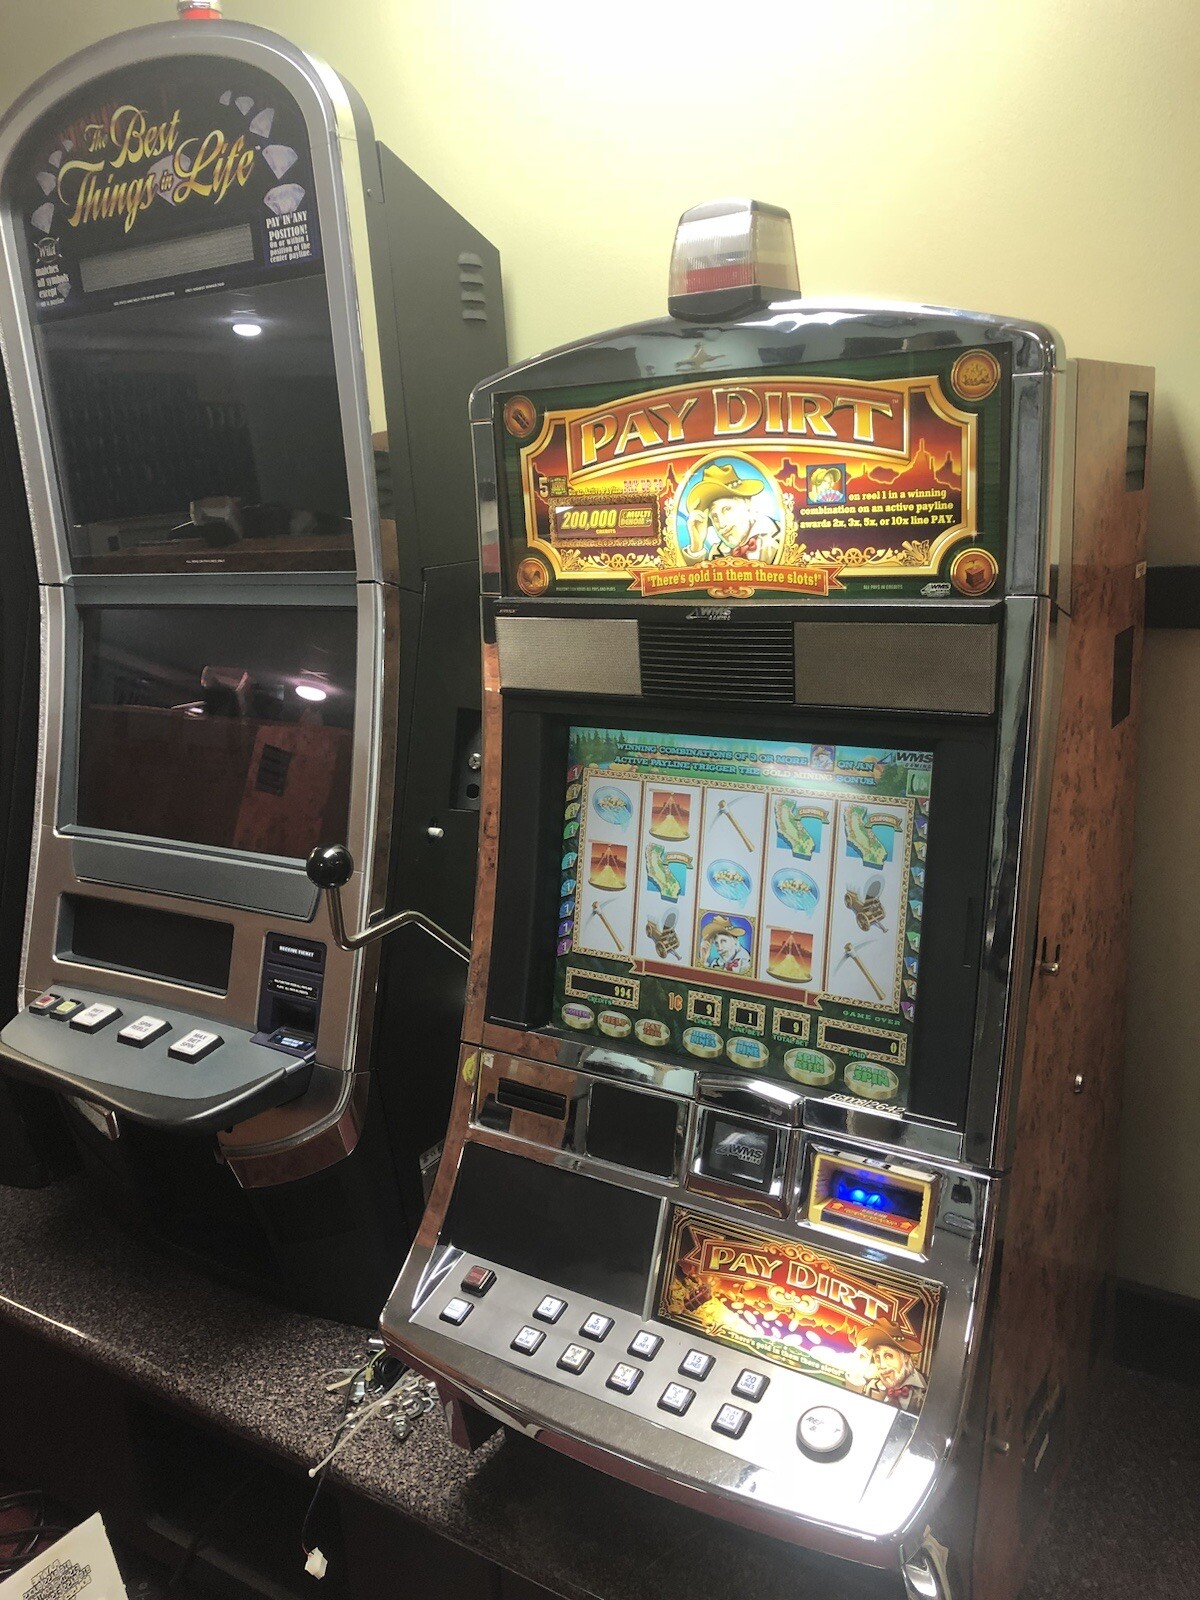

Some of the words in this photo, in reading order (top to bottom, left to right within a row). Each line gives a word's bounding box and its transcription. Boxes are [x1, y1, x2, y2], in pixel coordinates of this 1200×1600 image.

[84, 124, 108, 152] The
[109, 104, 181, 168] Best
[58, 160, 158, 233] Things
[160, 170, 174, 192] in
[173, 130, 255, 205] Life
[266, 216, 280, 228] PAY
[282, 214, 290, 225] IN
[292, 210, 308, 223] ANY
[269, 224, 308, 240] POSITION!
[581, 397, 698, 466] PAY
[712, 387, 894, 444] DIRT
[539, 476, 549, 498] 5
[862, 492, 880, 500] reel
[888, 490, 898, 499] in
[907, 488, 946, 500] winning
[800, 506, 856, 516] combination
[885, 502, 914, 512] active
[916, 501, 954, 514] payline
[562, 509, 618, 530] 200,000
[800, 519, 831, 528] awards
[833, 518, 846, 528] 2x,
[848, 518, 862, 528] 3x,
[864, 518, 878, 528] 5x,
[891, 516, 909, 526] 10x
[911, 516, 930, 524] line
[931, 514, 956, 524] PAY.
[688, 569, 710, 586] gold
[712, 569, 724, 580] in
[725, 569, 752, 582] them
[755, 569, 784, 584] there
[700, 607, 731, 615] WMS
[617, 743, 656, 754] WINNING
[660, 746, 732, 759] COMBINATIONS
[735, 752, 748, 760] OF
[759, 754, 774, 764] OR
[776, 756, 808, 766] MORE
[837, 760, 854, 769] ON
[897, 752, 933, 762] WMS
[614, 756, 648, 766] ACTIVE
[650, 758, 690, 769] PAYLINE
[692, 762, 736, 774] TRIGGER
[738, 766, 760, 776] THE
[762, 768, 792, 778] GOLD
[794, 772, 832, 782] MINING
[614, 986, 632, 999] 994
[706, 1004, 712, 1015] 9
[602, 1015, 628, 1028] HELP
[748, 1012, 752, 1024] 1
[842, 1010, 872, 1020] GAME
[874, 1016, 901, 1026] OVER
[793, 1021, 800, 1033] 9
[772, 1033, 795, 1044] TOTAL
[796, 1038, 808, 1047] BET
[848, 1050, 866, 1060] PAID
[890, 1042, 898, 1054] 0
[795, 1052, 825, 1064] SPIN
[853, 1070, 889, 1088] SPIN
[730, 1144, 764, 1158] WMS
[709, 1246, 783, 1279] PAY
[786, 1260, 889, 1321] DIRT
[693, 1354, 702, 1362] 15
[744, 1374, 757, 1384] 20
